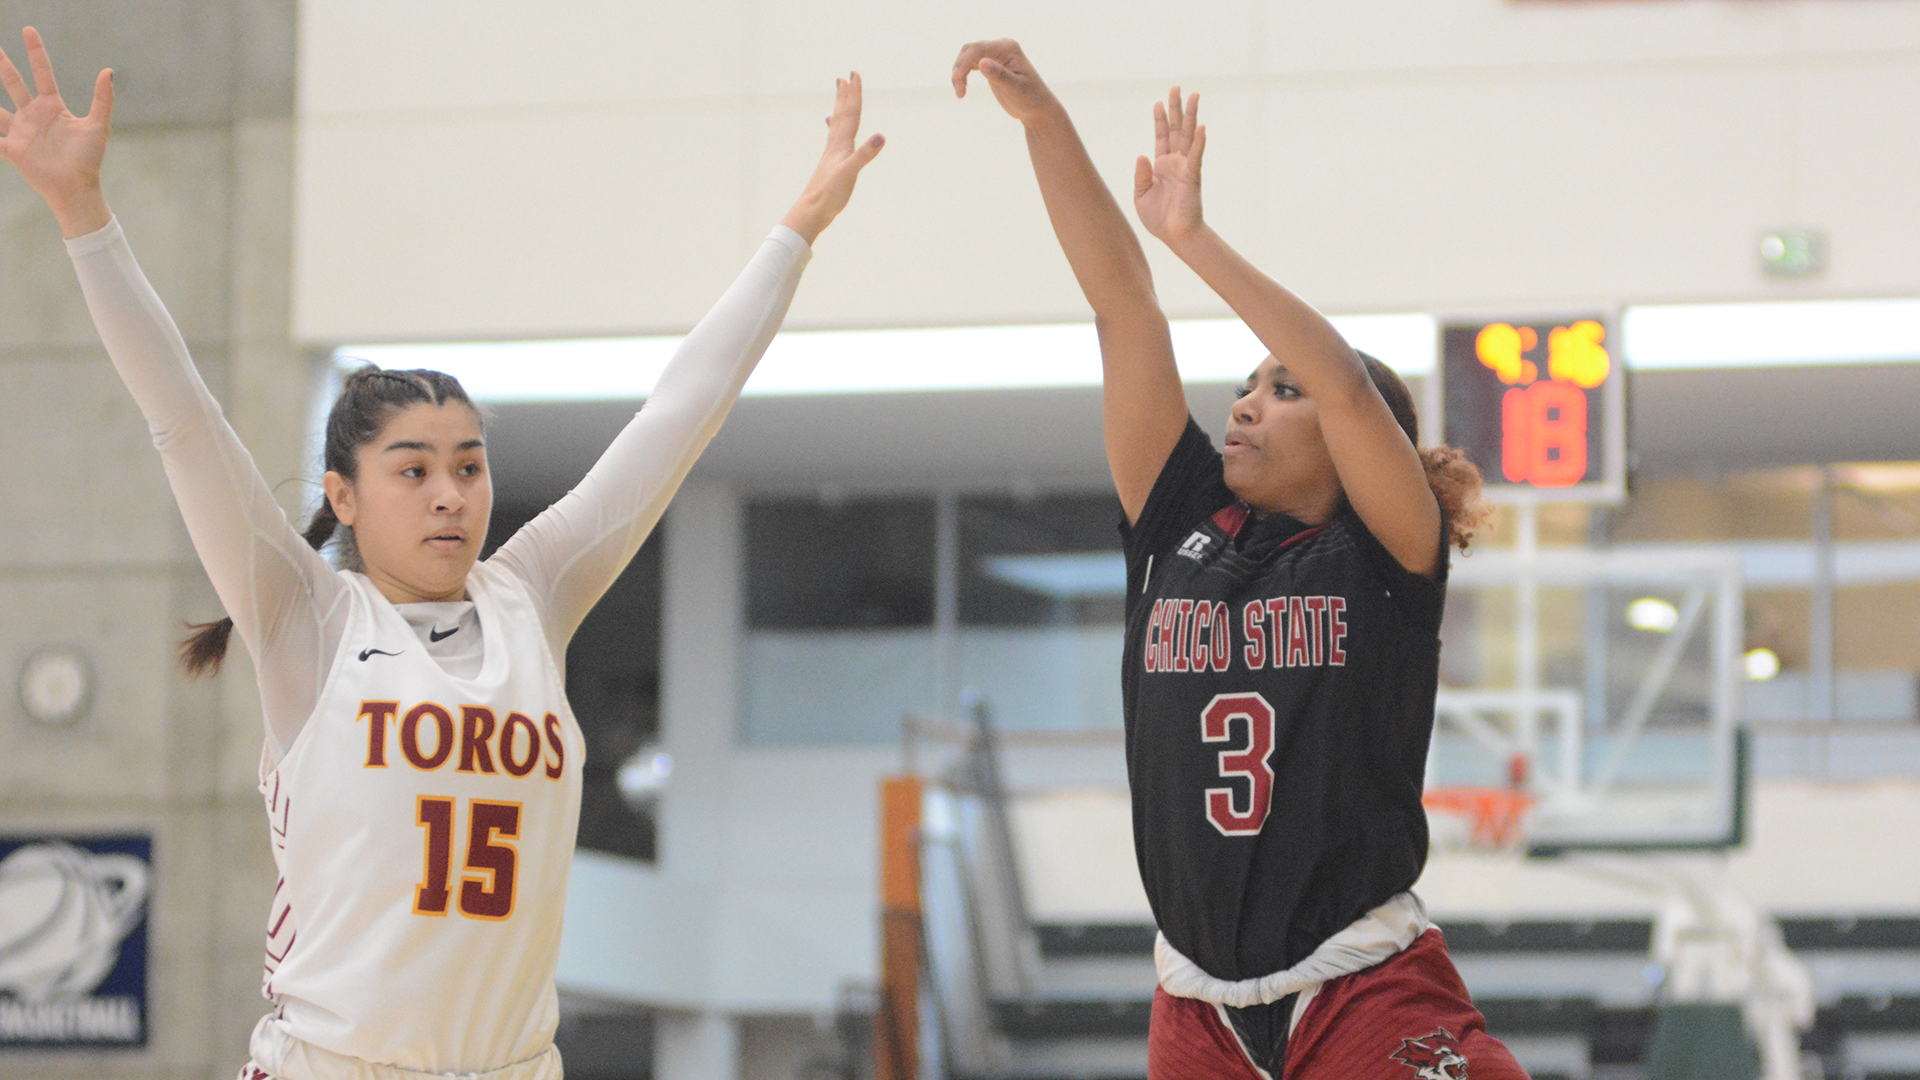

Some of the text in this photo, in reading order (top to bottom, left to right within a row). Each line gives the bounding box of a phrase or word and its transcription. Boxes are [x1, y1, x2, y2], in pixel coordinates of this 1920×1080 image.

[1502, 381, 1587, 487] 18
[1144, 595, 1347, 672] CHICO STATE
[355, 699, 565, 782] TOROS
[1200, 691, 1275, 836] 3
[411, 793, 523, 922] 15
